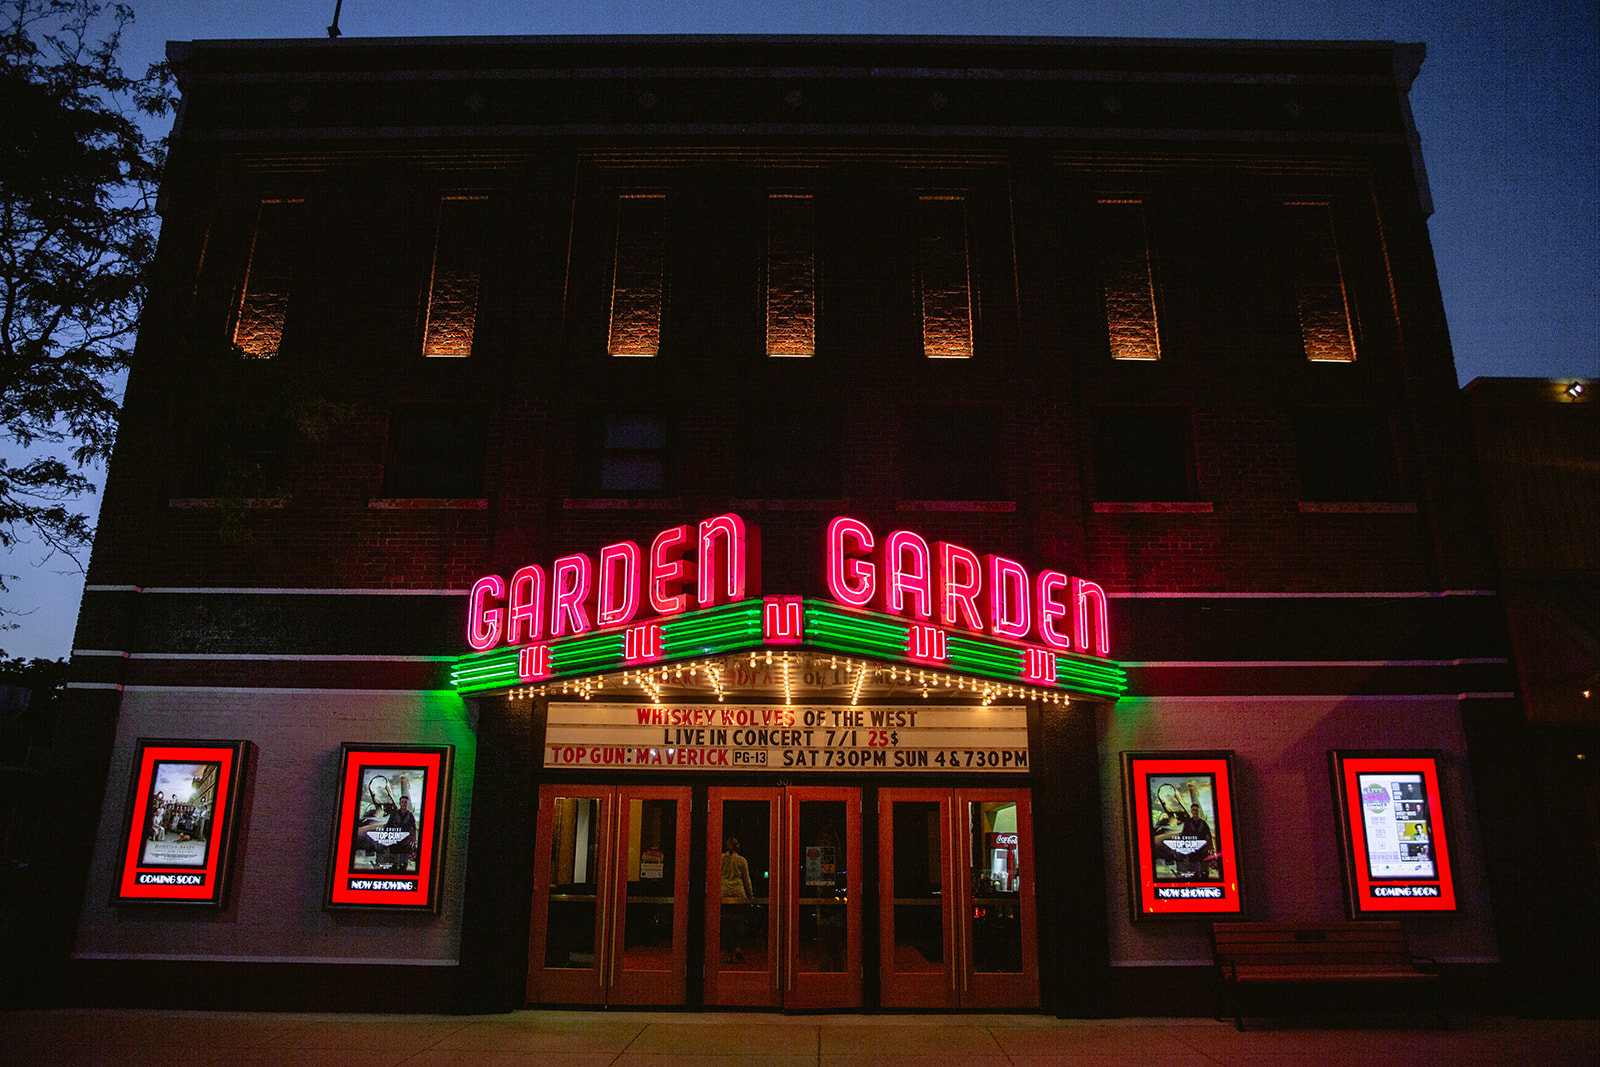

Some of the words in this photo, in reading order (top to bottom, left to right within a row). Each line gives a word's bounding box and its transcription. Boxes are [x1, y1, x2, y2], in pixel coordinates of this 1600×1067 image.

[467, 512, 747, 650] GARDEN
[826, 515, 1110, 657] GARDEN
[637, 708, 716, 725] WHISKEY
[721, 709, 796, 727] WOLVES
[803, 710, 826, 727] OF
[832, 710, 864, 727] THE
[870, 710, 918, 727] WEST
[664, 728, 705, 745] LIVE
[710, 729, 727, 745] IN
[733, 729, 814, 747] CONCERT
[826, 730, 857, 747] 7/1
[868, 730, 899, 747] 25$
[552, 746, 586, 764] TOP
[636, 748, 729, 766] MAVERICK
[734, 751, 767, 765] PG-13
[783, 749, 819, 767] SAT
[824, 750, 887, 767] 730PM
[894, 750, 929, 767] SUN
[140, 875, 176, 884] COMING
[176, 875, 201, 885] SOON
[351, 880, 373, 889] NOW
[373, 881, 413, 891] SHOWING
[1158, 888, 1181, 898] NOW
[1181, 888, 1221, 898] SHOWING
[1374, 887, 1411, 897] COMING
[1411, 887, 1438, 897] SOON
